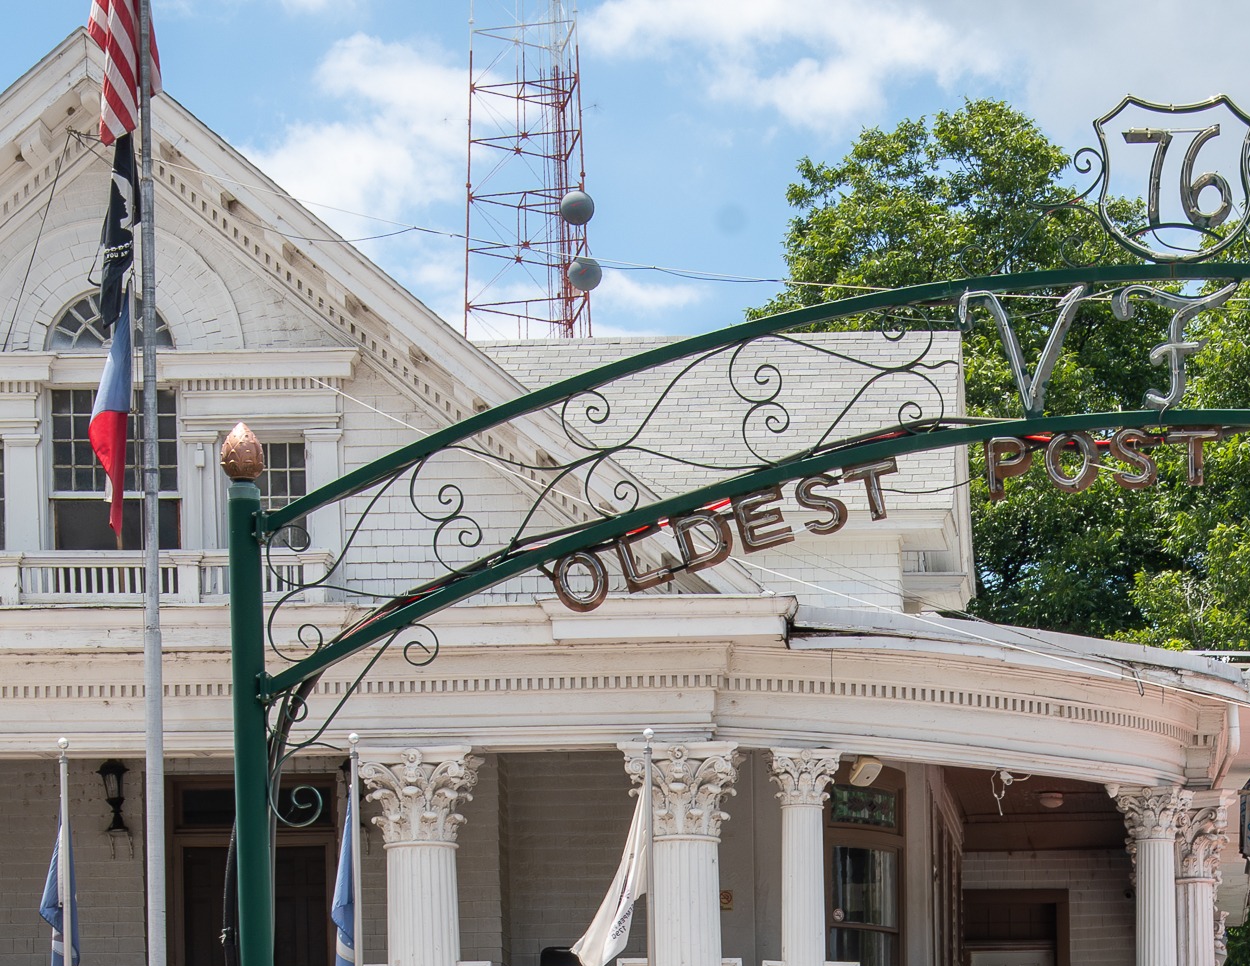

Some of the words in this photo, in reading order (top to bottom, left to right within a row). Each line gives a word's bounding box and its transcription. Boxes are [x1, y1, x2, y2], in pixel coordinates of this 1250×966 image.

[1121, 123, 1232, 228] 76
[552, 456, 898, 612] OLDEST
[983, 425, 1222, 500] POST
